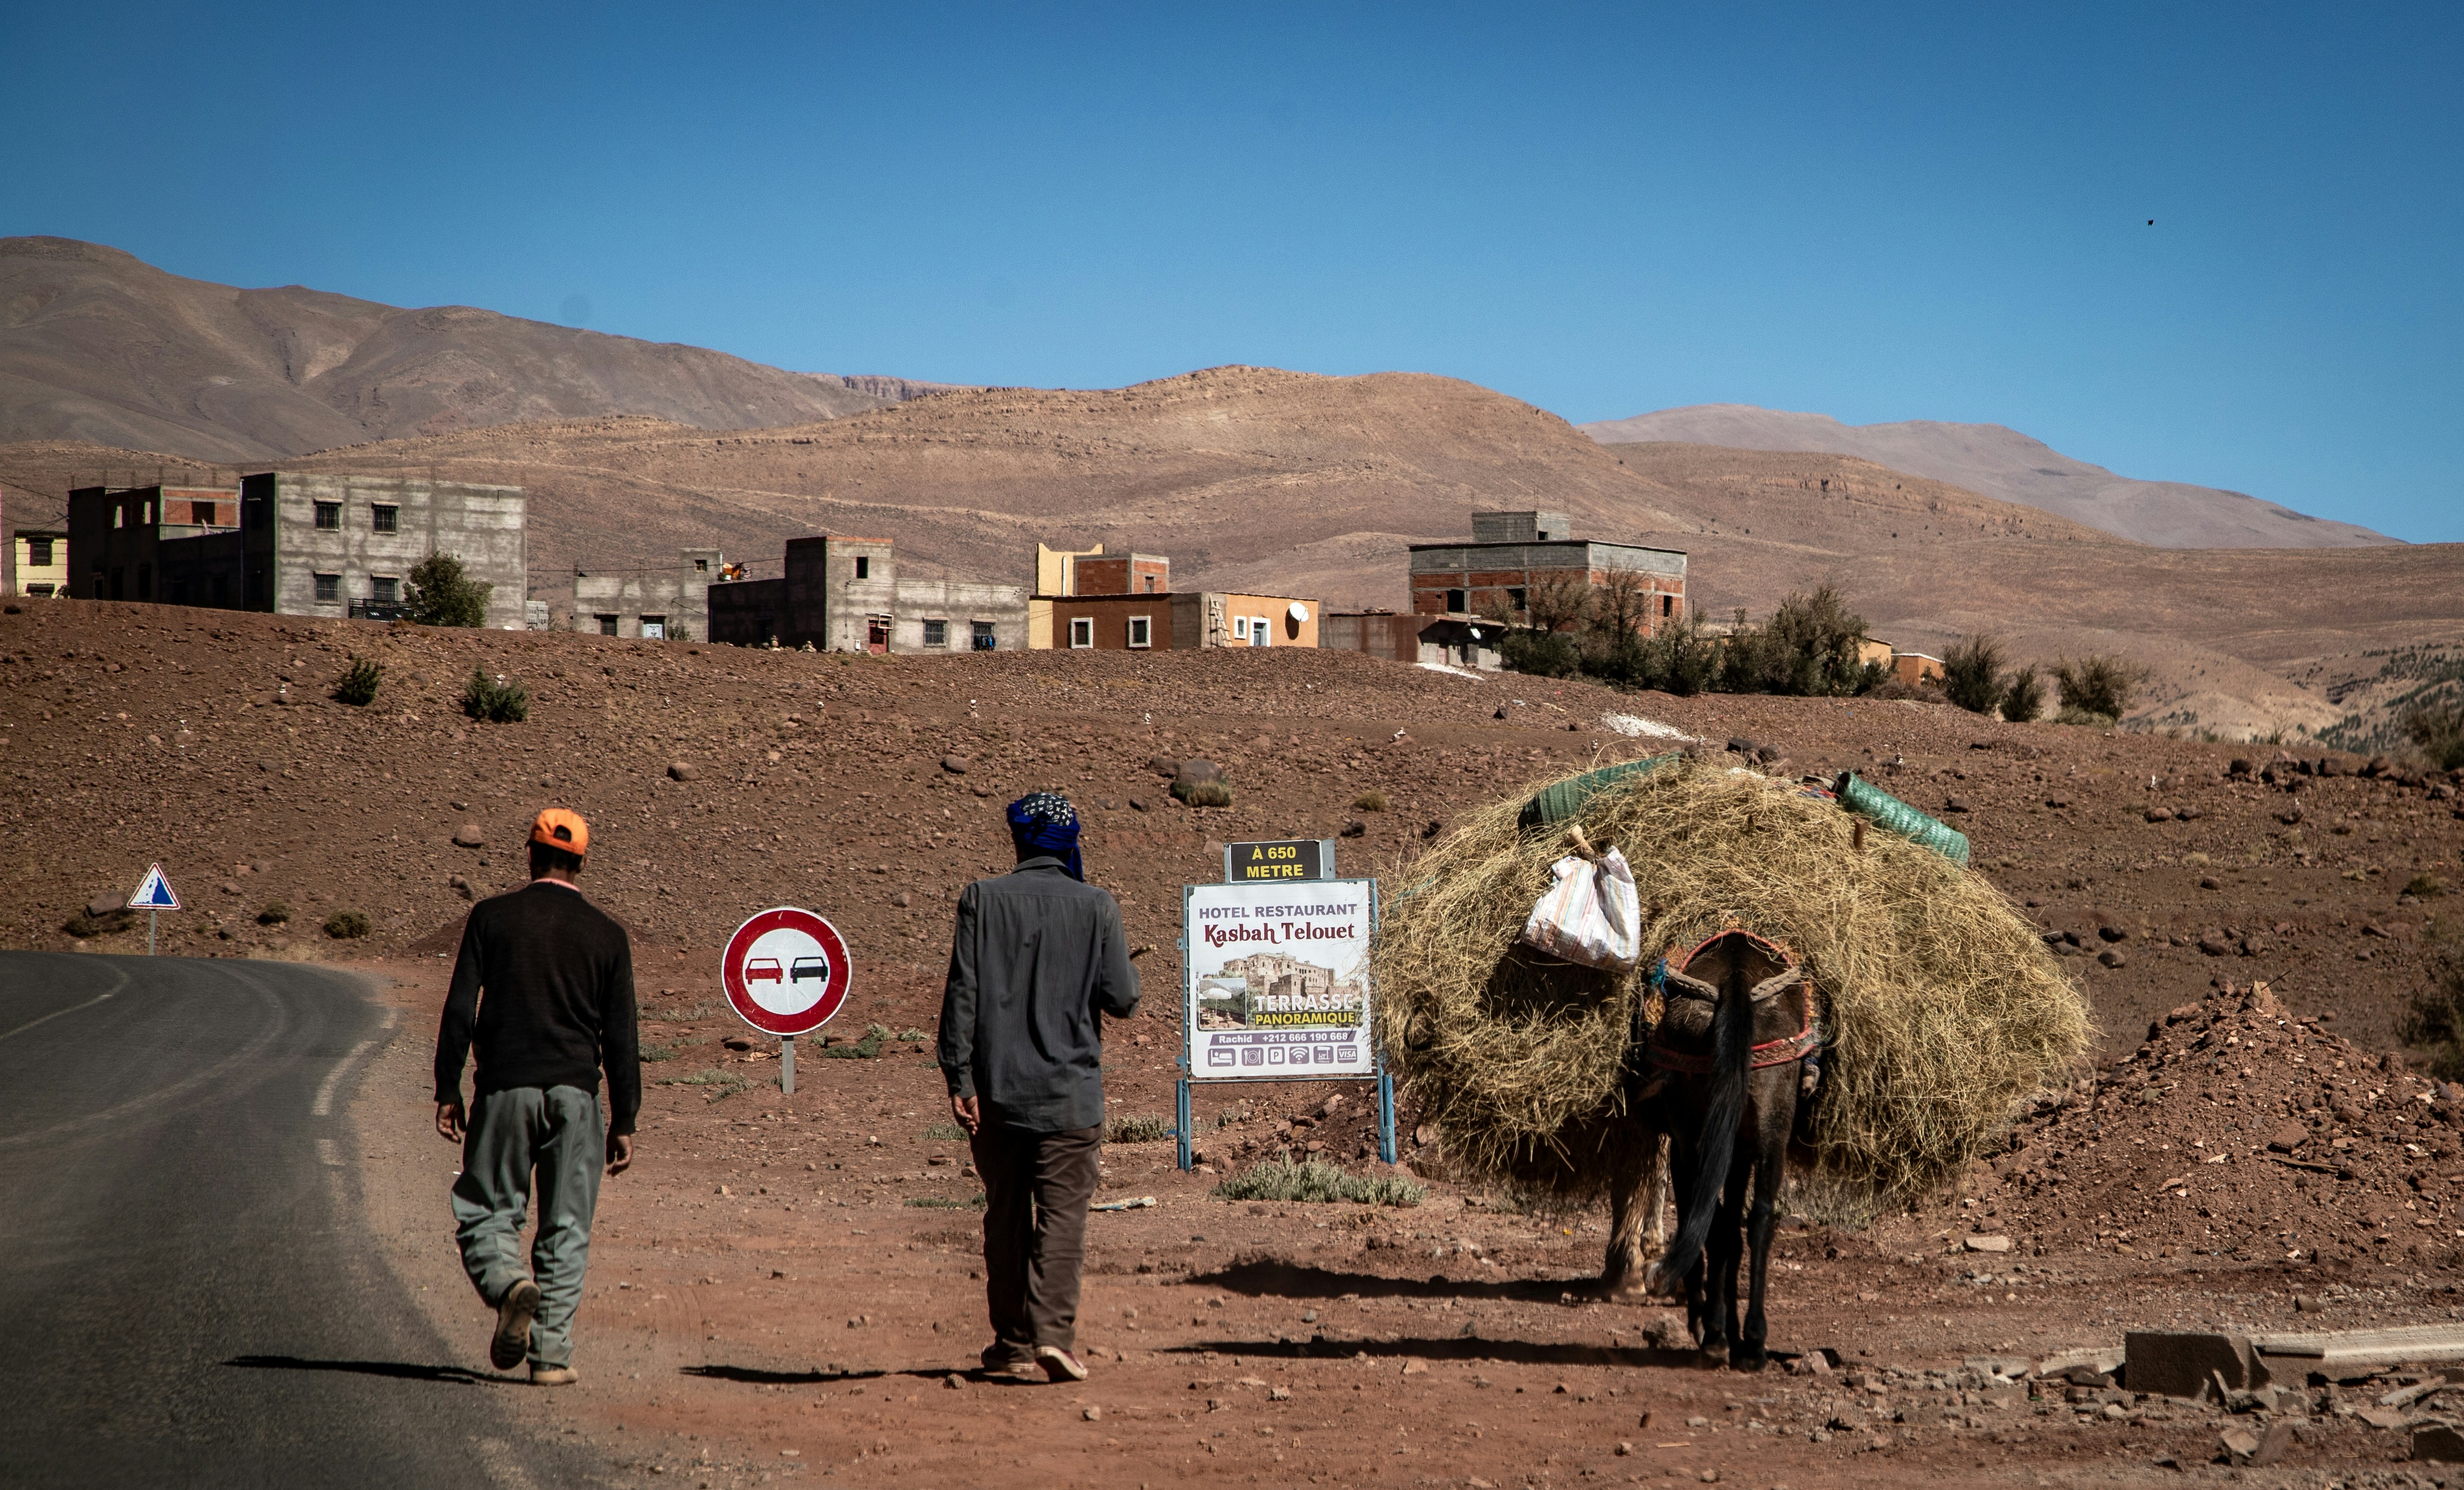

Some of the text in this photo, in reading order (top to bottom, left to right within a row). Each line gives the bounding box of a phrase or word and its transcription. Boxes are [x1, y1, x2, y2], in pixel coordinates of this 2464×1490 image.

[1251, 845, 1296, 860] À 650
[1247, 864, 1303, 878] METRE
[1199, 903, 1357, 919] HOTEL RESTAURANT
[1204, 922, 1355, 948] Kasbah Telouet
[1254, 993, 1354, 1012] TERRASSE
[1255, 1012, 1355, 1025] PANORAMIQUE
[1218, 1032, 1348, 1044] Rachid +212 666 190 668
[1274, 1051, 1279, 1060] P
